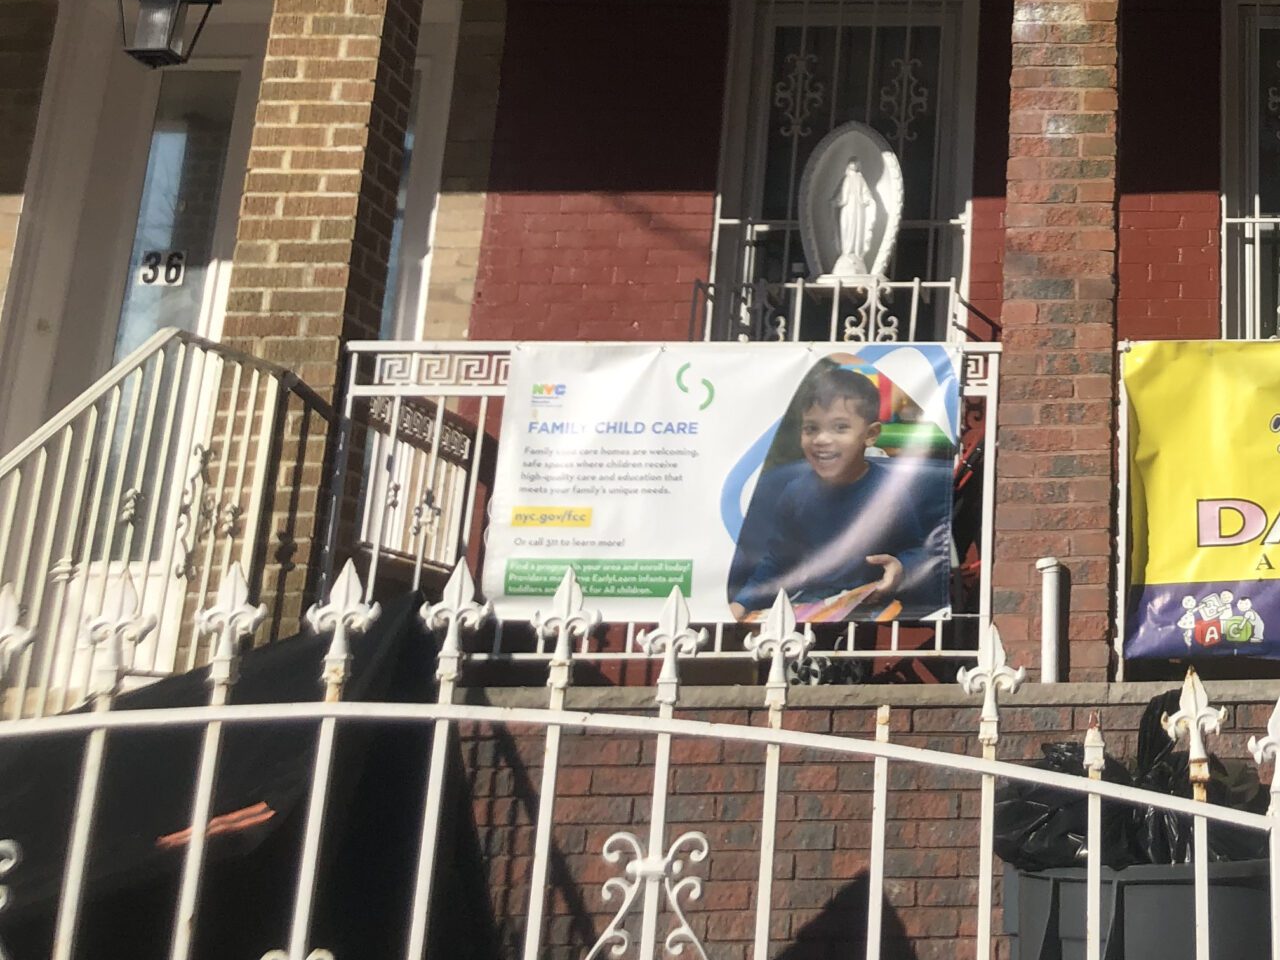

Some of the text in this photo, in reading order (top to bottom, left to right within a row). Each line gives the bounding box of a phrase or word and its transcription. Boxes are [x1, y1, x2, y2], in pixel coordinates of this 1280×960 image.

[142, 251, 184, 284] 36
[532, 383, 566, 395] NYC
[528, 421, 699, 434] FAMILY CHILD CARE
[524, 446, 553, 457] Family
[600, 446, 630, 456] homes
[523, 460, 542, 468] safe
[576, 459, 604, 468] where
[606, 460, 642, 468] children
[644, 460, 678, 468] receive
[598, 473, 615, 481] and
[617, 472, 662, 481] education
[664, 473, 683, 481] that
[519, 486, 548, 494] meets
[608, 486, 639, 496] unique
[514, 511, 587, 523] nyc.gov/fcc
[514, 538, 527, 546] Or
[529, 538, 543, 546] call
[572, 538, 596, 546] learn
[623, 562, 638, 571] and
[1255, 553, 1275, 571] A
[668, 573, 684, 582] and
[1205, 626, 1219, 643] A
